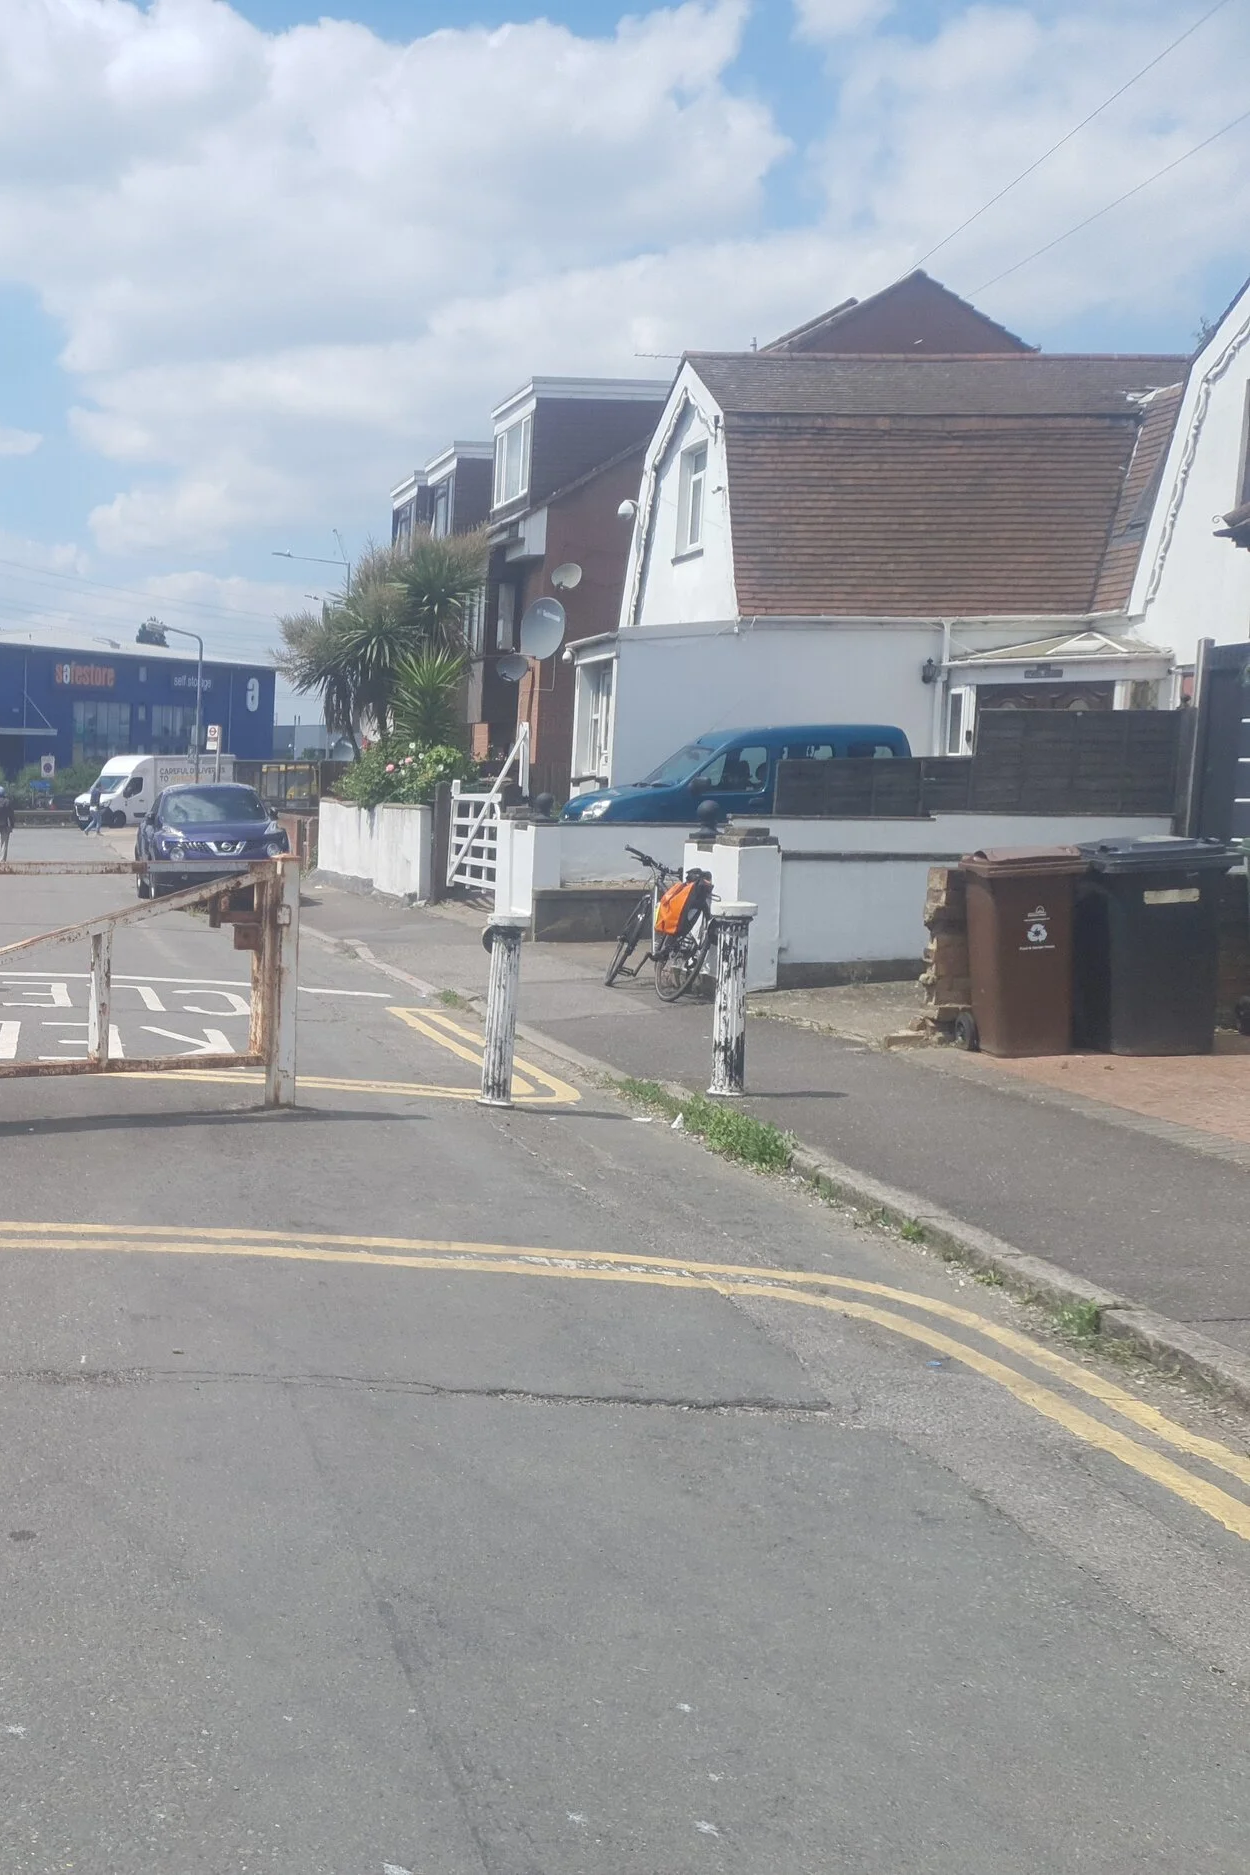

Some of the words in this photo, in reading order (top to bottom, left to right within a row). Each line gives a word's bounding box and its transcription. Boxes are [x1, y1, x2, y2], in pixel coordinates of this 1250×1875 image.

[55, 660, 115, 687] safestore
[174, 675, 187, 687] self
[187, 676, 212, 691] stoage
[159, 767, 189, 775] CAREFUL
[159, 775, 169, 783] TO
